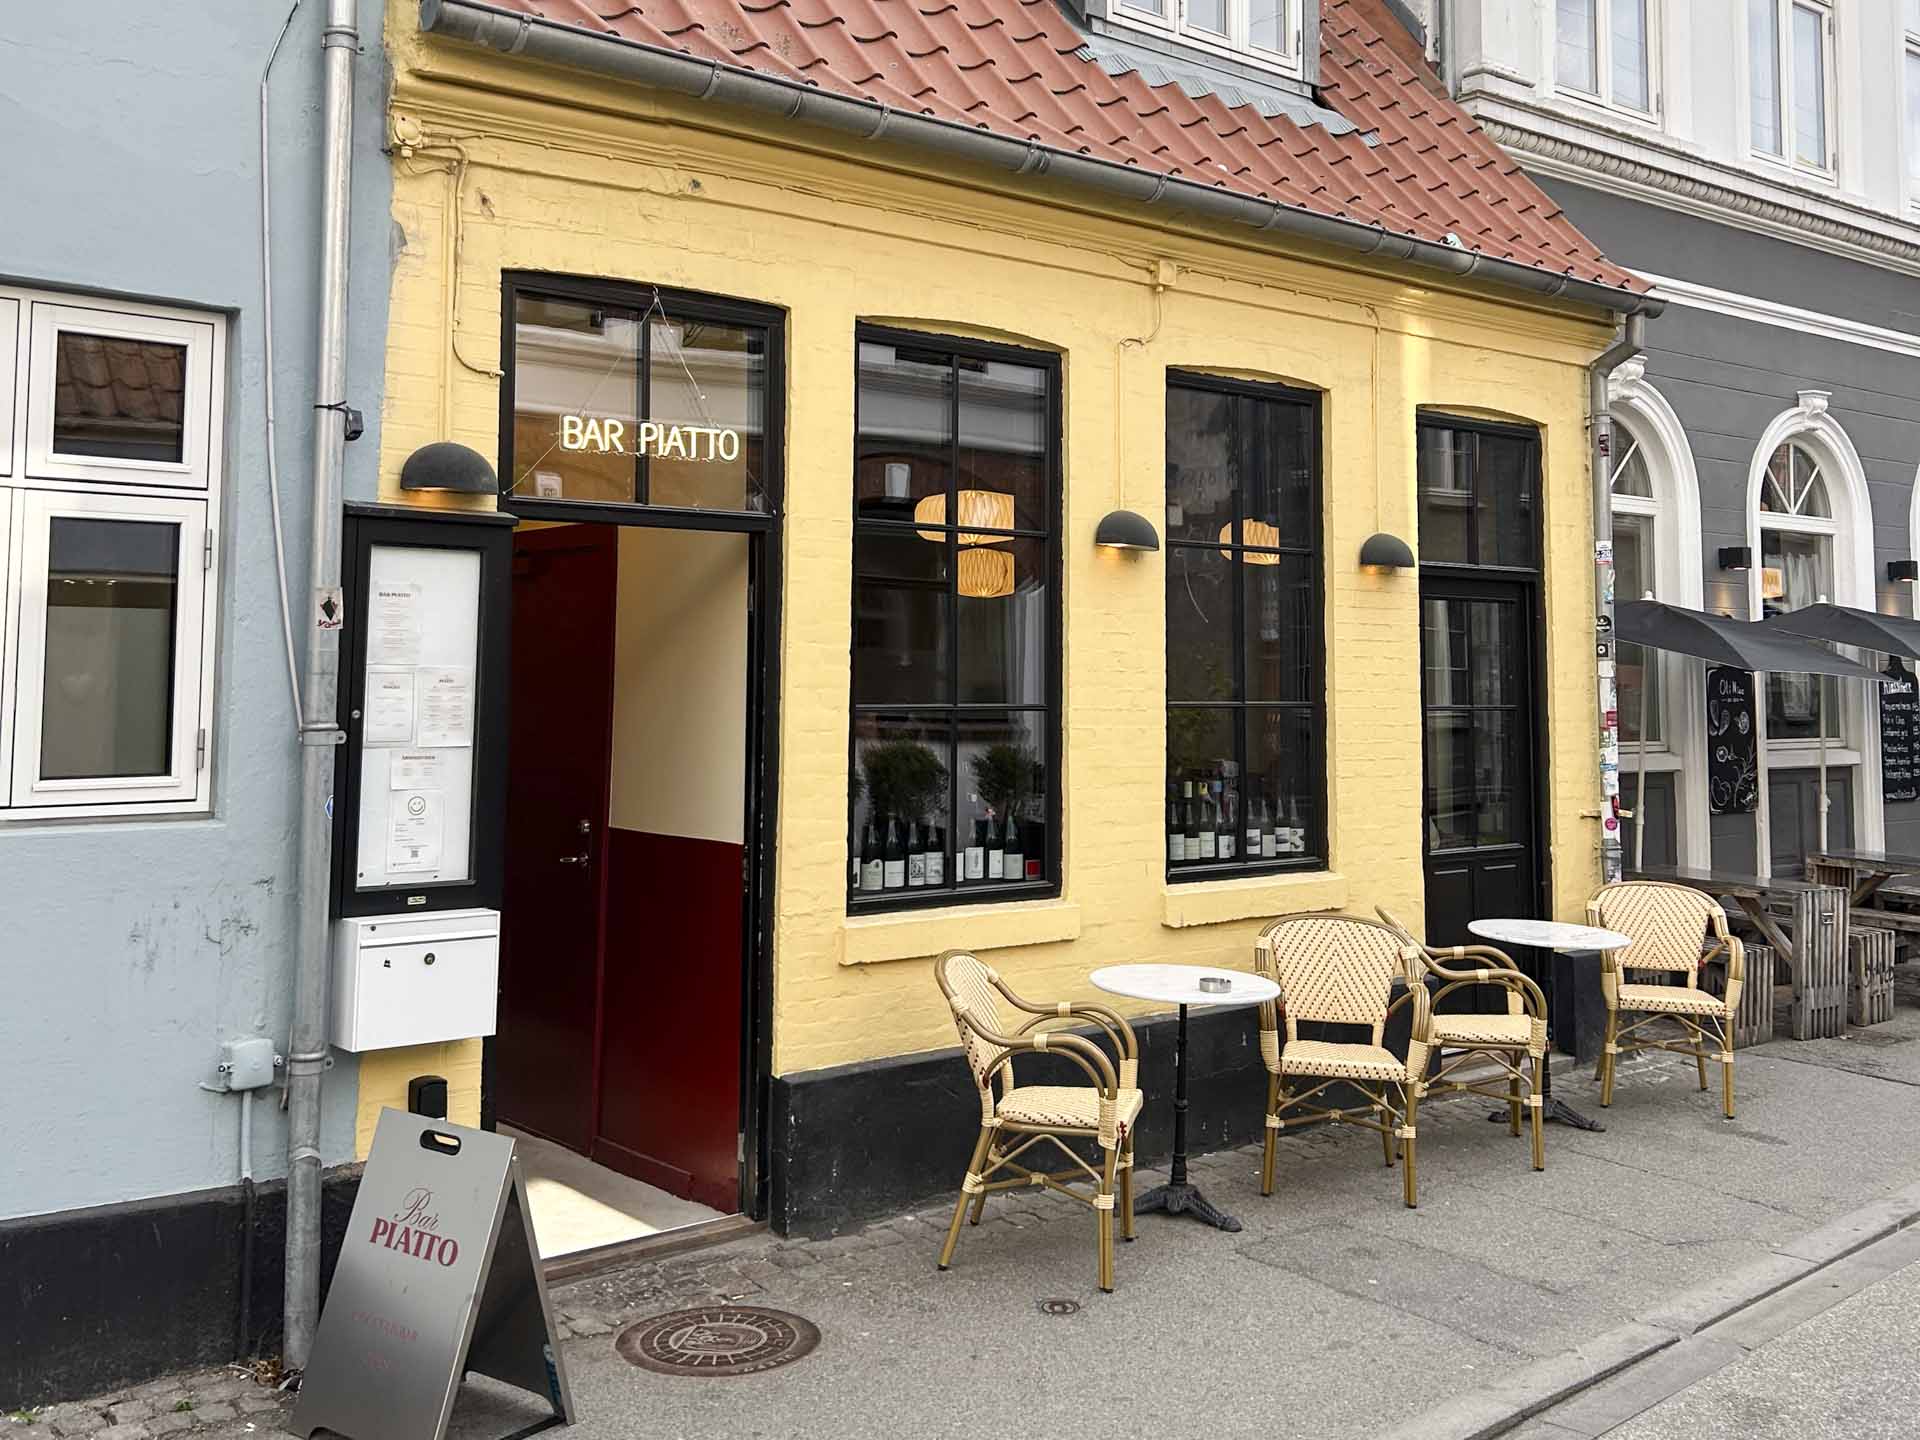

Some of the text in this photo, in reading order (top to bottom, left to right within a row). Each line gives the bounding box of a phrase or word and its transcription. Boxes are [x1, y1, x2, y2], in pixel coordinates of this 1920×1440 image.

[562, 415, 740, 461] BAR PIATTO
[394, 1188, 440, 1230] Bar
[369, 1217, 459, 1267] PIATTO
